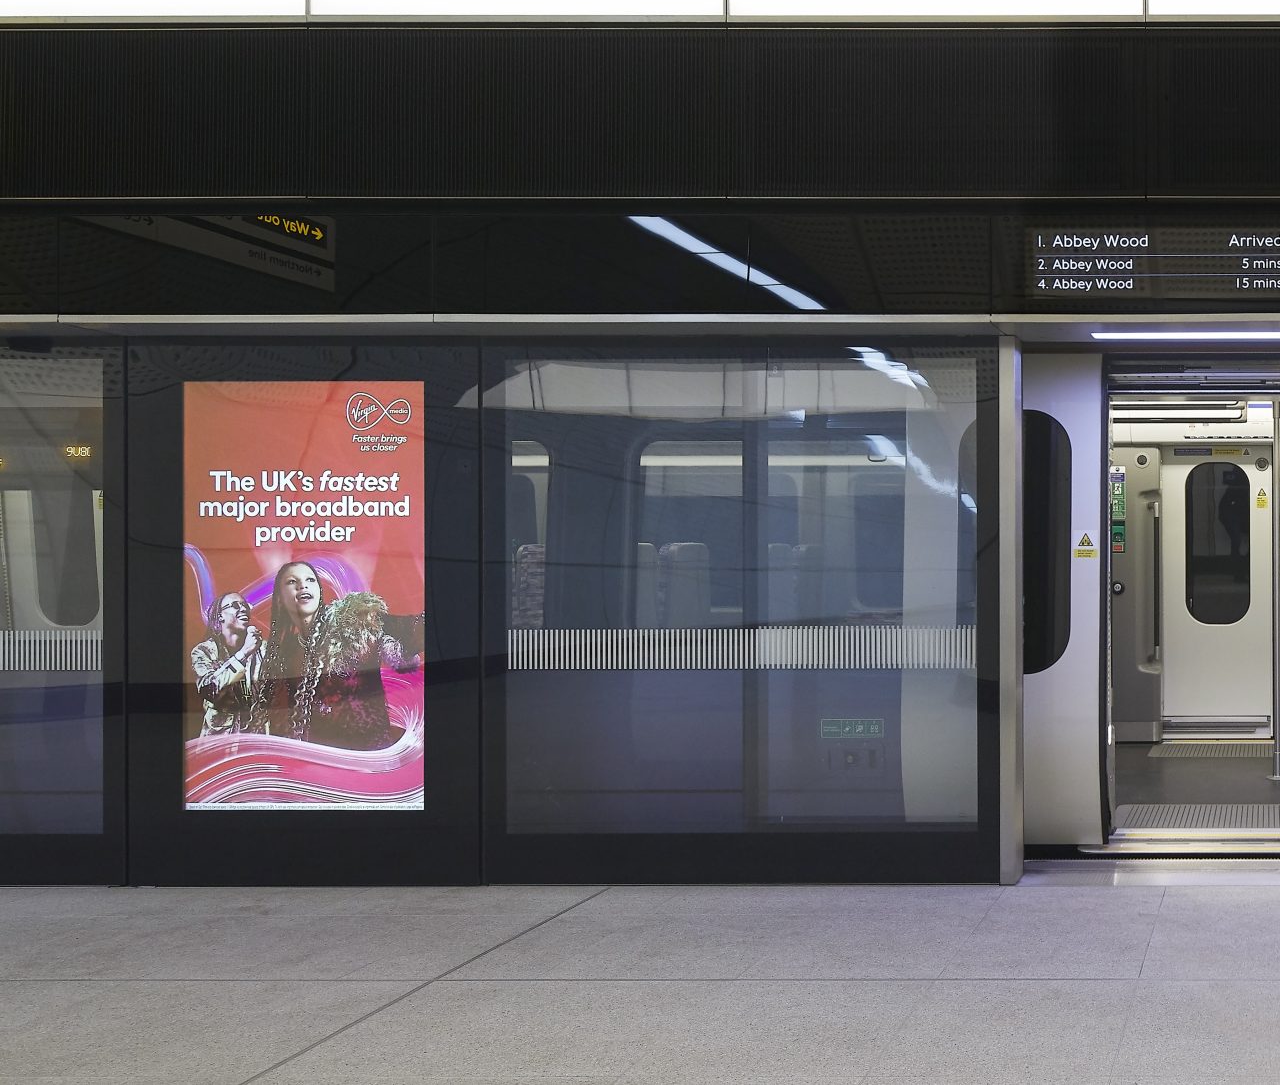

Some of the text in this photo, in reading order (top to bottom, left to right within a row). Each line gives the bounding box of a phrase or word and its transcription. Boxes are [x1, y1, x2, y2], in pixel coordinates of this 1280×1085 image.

[1038, 234, 1046, 248] 1.
[1052, 234, 1100, 250] Abbey
[1104, 234, 1149, 248] Wood
[1038, 258, 1048, 270] 2.
[1052, 258, 1093, 273] Abbey
[1095, 258, 1133, 270] Wood
[1241, 258, 1250, 269] 5
[1038, 278, 1049, 290] 4.
[1052, 277, 1093, 292] Abbey
[1095, 277, 1133, 290] Wood
[1235, 277, 1250, 289] 15
[351, 399, 379, 424] Virgin
[352, 434, 408, 445] Faster brings
[360, 443, 398, 452] us closer
[209, 470, 400, 492] The UK’s fastest
[199, 495, 410, 522] major broadband
[255, 520, 356, 547] provider
